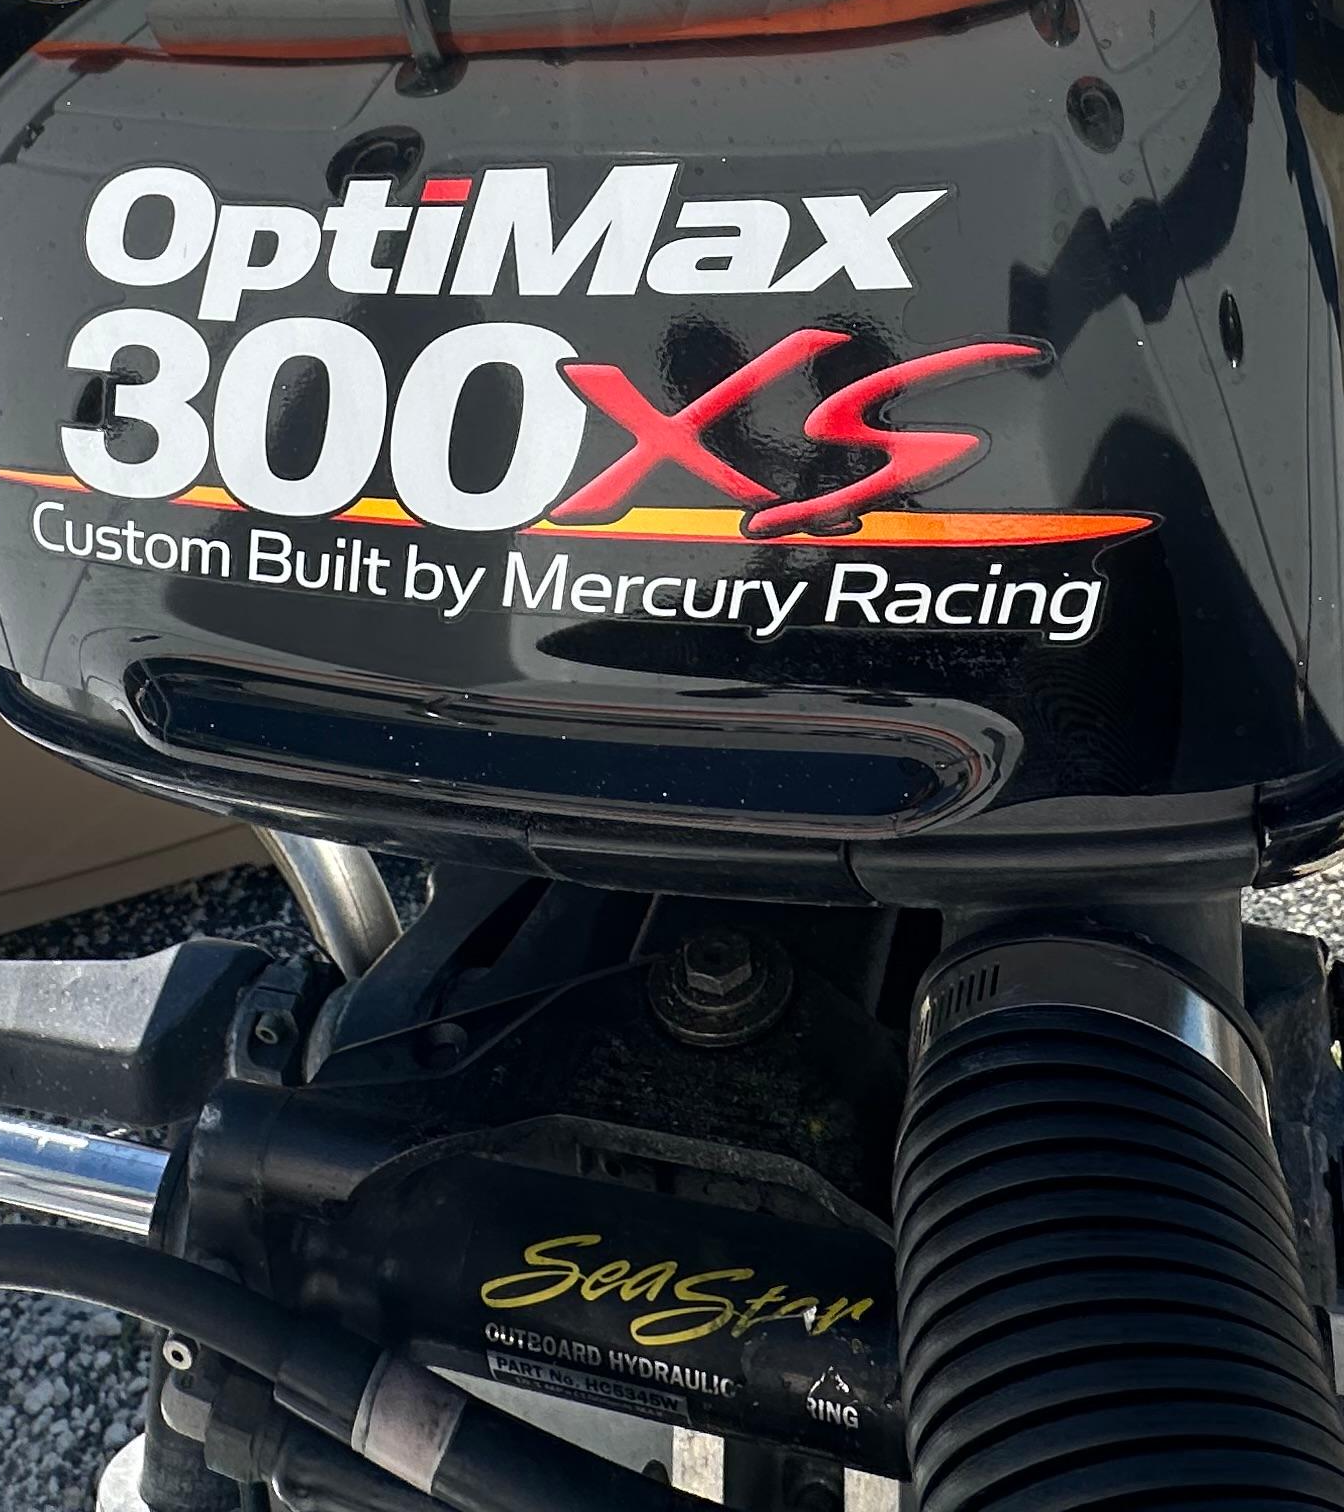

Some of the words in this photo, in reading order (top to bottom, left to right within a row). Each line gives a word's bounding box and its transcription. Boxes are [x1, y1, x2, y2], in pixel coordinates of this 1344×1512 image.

[85, 163, 948, 322] OptiMax
[31, 500, 230, 578] Custom
[248, 528, 391, 596] Built
[404, 543, 487, 617] by
[502, 551, 809, 637] Mercury
[824, 563, 1102, 641] Racing
[485, 1322, 602, 1366] OUTBOARD
[609, 1350, 737, 1398] HYDRAULIC
[496, 1352, 543, 1376] PART
